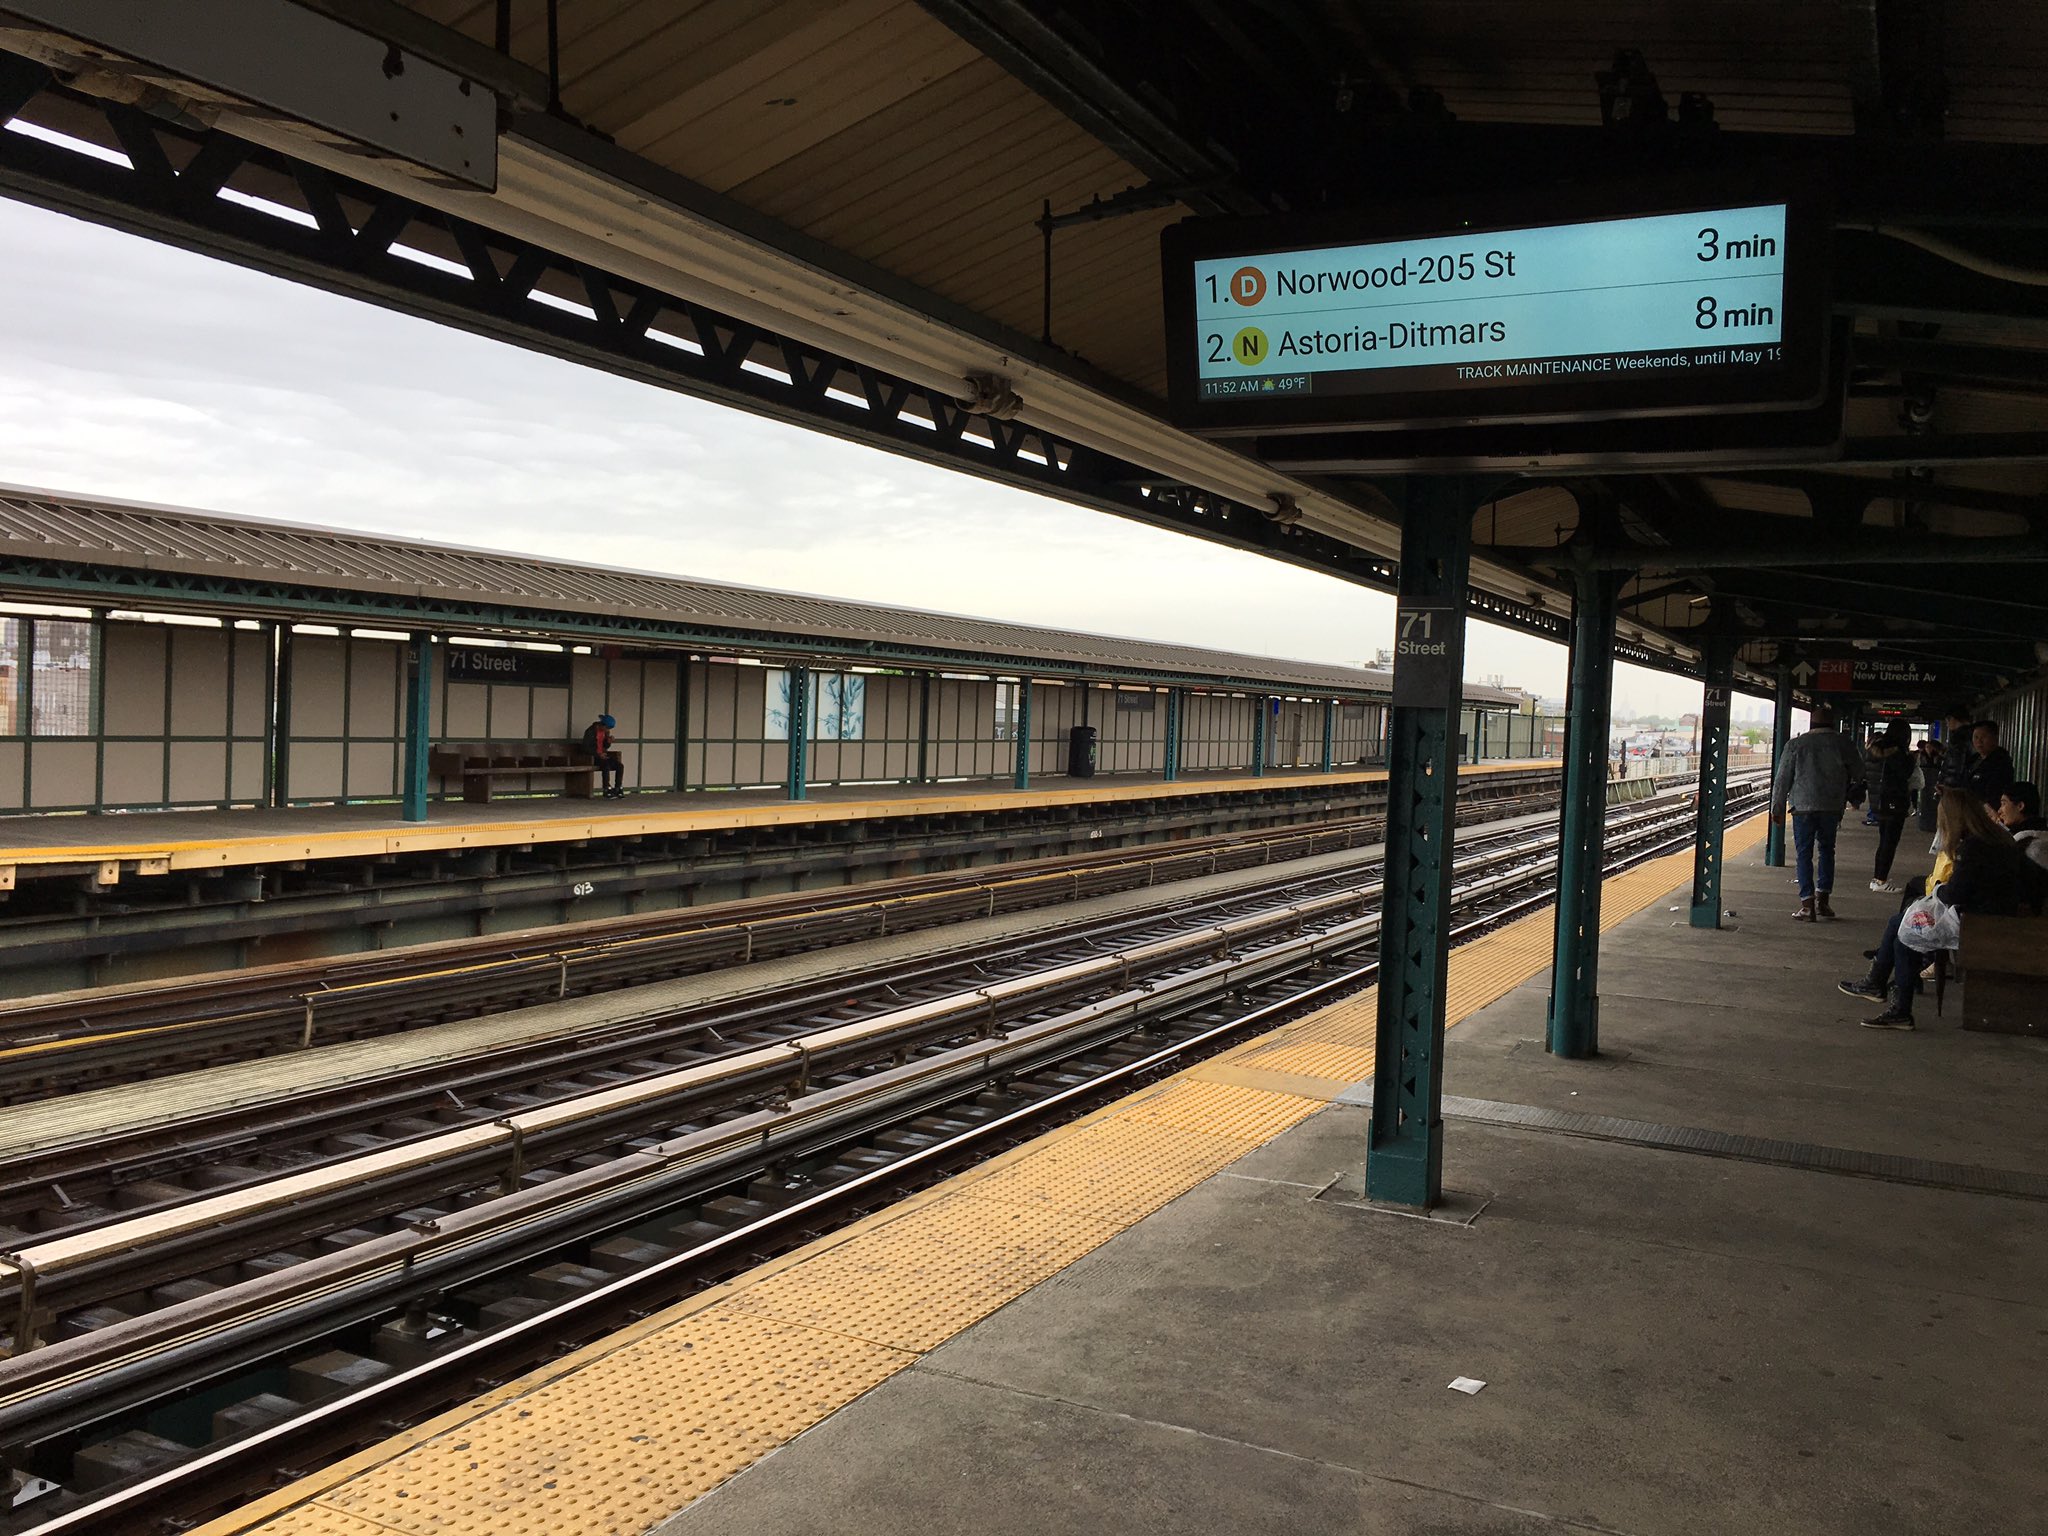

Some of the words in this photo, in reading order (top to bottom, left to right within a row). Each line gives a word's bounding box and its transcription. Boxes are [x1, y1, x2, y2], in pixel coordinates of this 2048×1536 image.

[1205, 274, 1229, 303] 1.
[1240, 275, 1258, 298] D
[1277, 252, 1475, 296] Norwood-205
[1484, 250, 1516, 278] St
[1696, 227, 1719, 262] 3
[1726, 233, 1776, 260] min
[1206, 333, 1231, 363] 2.
[1242, 335, 1258, 357] N
[1278, 321, 1506, 357] Astoria-Ditmars
[1695, 296, 1717, 330] 8
[1723, 302, 1773, 328] min
[1456, 365, 1503, 379] TRACK
[1506, 358, 1612, 377] MAINTENANCE
[1615, 353, 1692, 370] Weekends,
[1695, 350, 1726, 366] until
[1730, 348, 1762, 365] May
[1205, 382, 1237, 394] 11:52
[1239, 380, 1259, 392] AM
[1400, 612, 1432, 639] 71
[1398, 640, 1446, 655] Street
[450, 651, 467, 669] 71
[472, 652, 518, 672] Street
[1819, 660, 1849, 674] Exit
[1854, 661, 1868, 671] 70
[1872, 661, 1905, 672] Street
[1908, 662, 1917, 672] &
[1853, 671, 1877, 680] New
[1880, 671, 1919, 681] Utrecht
[1923, 672, 1937, 682] Av
[1706, 689, 1720, 700] 71
